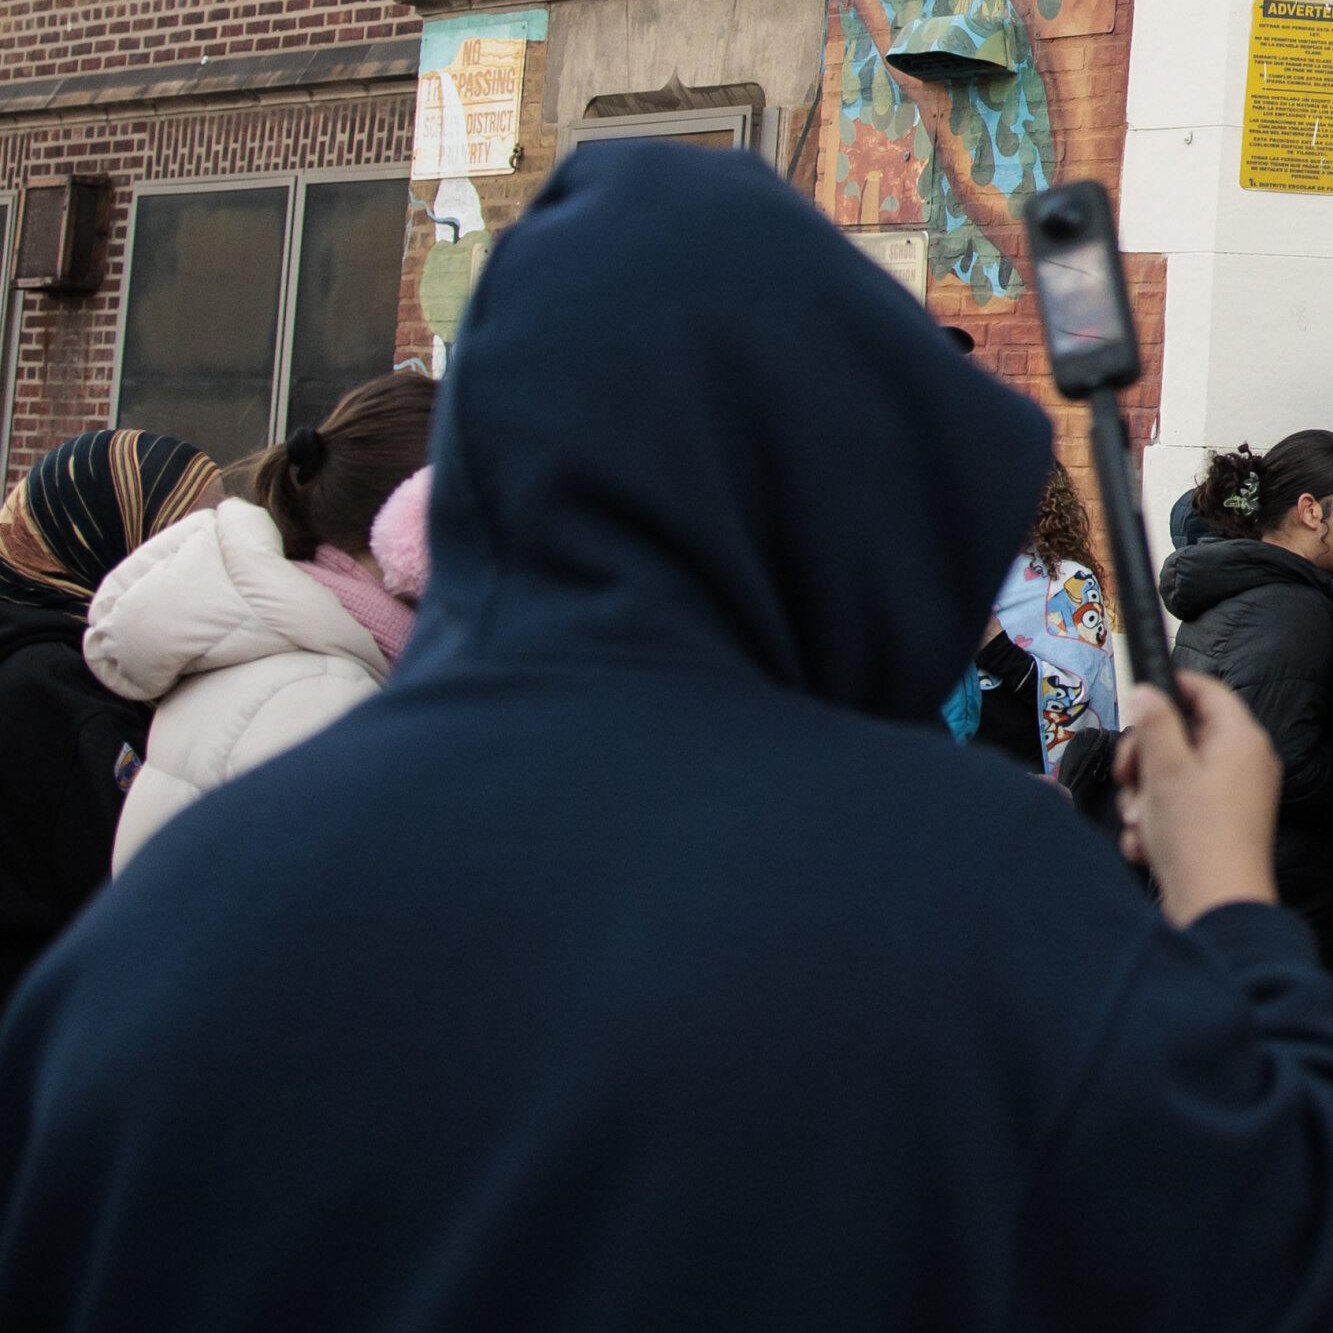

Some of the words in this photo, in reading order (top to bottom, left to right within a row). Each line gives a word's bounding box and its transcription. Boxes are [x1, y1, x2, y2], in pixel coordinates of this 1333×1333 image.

[463, 39, 482, 66] NO
[426, 68, 516, 102] TRPASSING
[466, 109, 514, 135] DISTRICT
